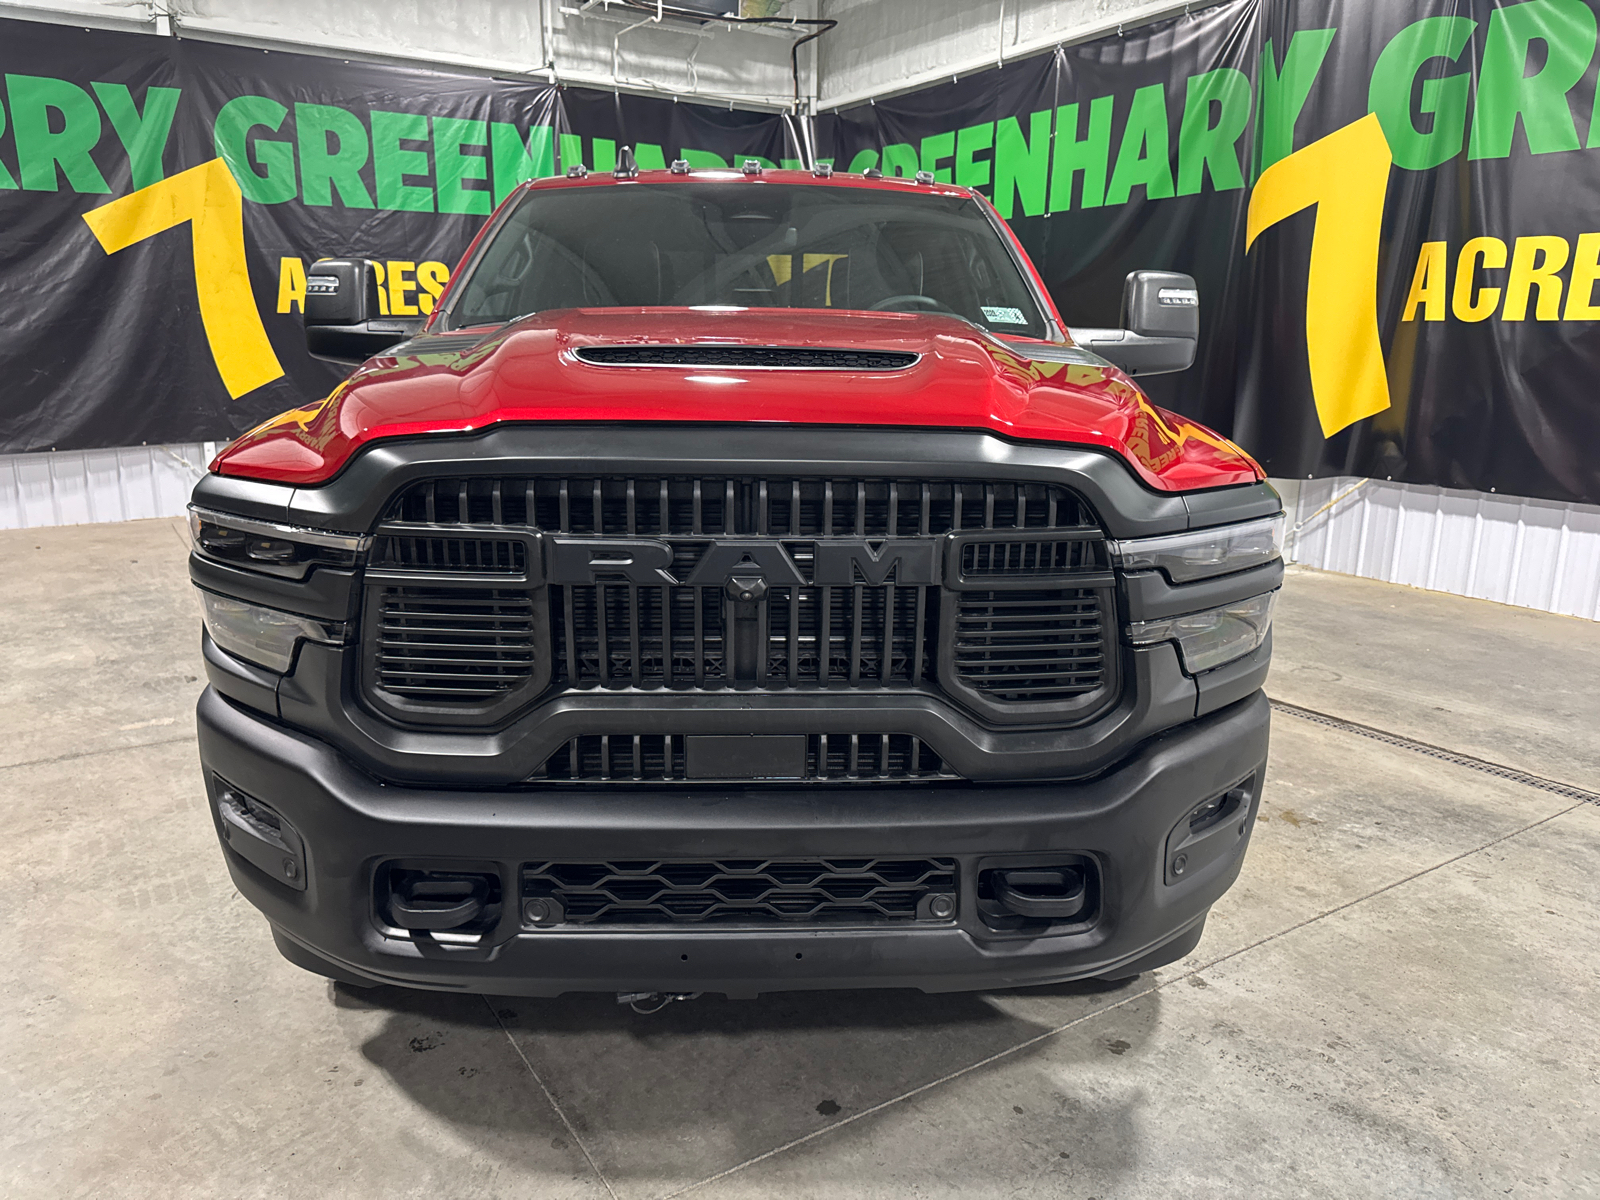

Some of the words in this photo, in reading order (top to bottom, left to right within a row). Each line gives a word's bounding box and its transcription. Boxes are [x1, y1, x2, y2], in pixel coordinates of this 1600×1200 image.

[0, 74, 181, 194] RY
[214, 96, 555, 215] GREEN
[1368, 0, 1600, 170] GR
[82, 157, 285, 400] 7
[277, 257, 450, 315] AES
[1246, 112, 1392, 439] 7
[553, 537, 936, 586] RAM
